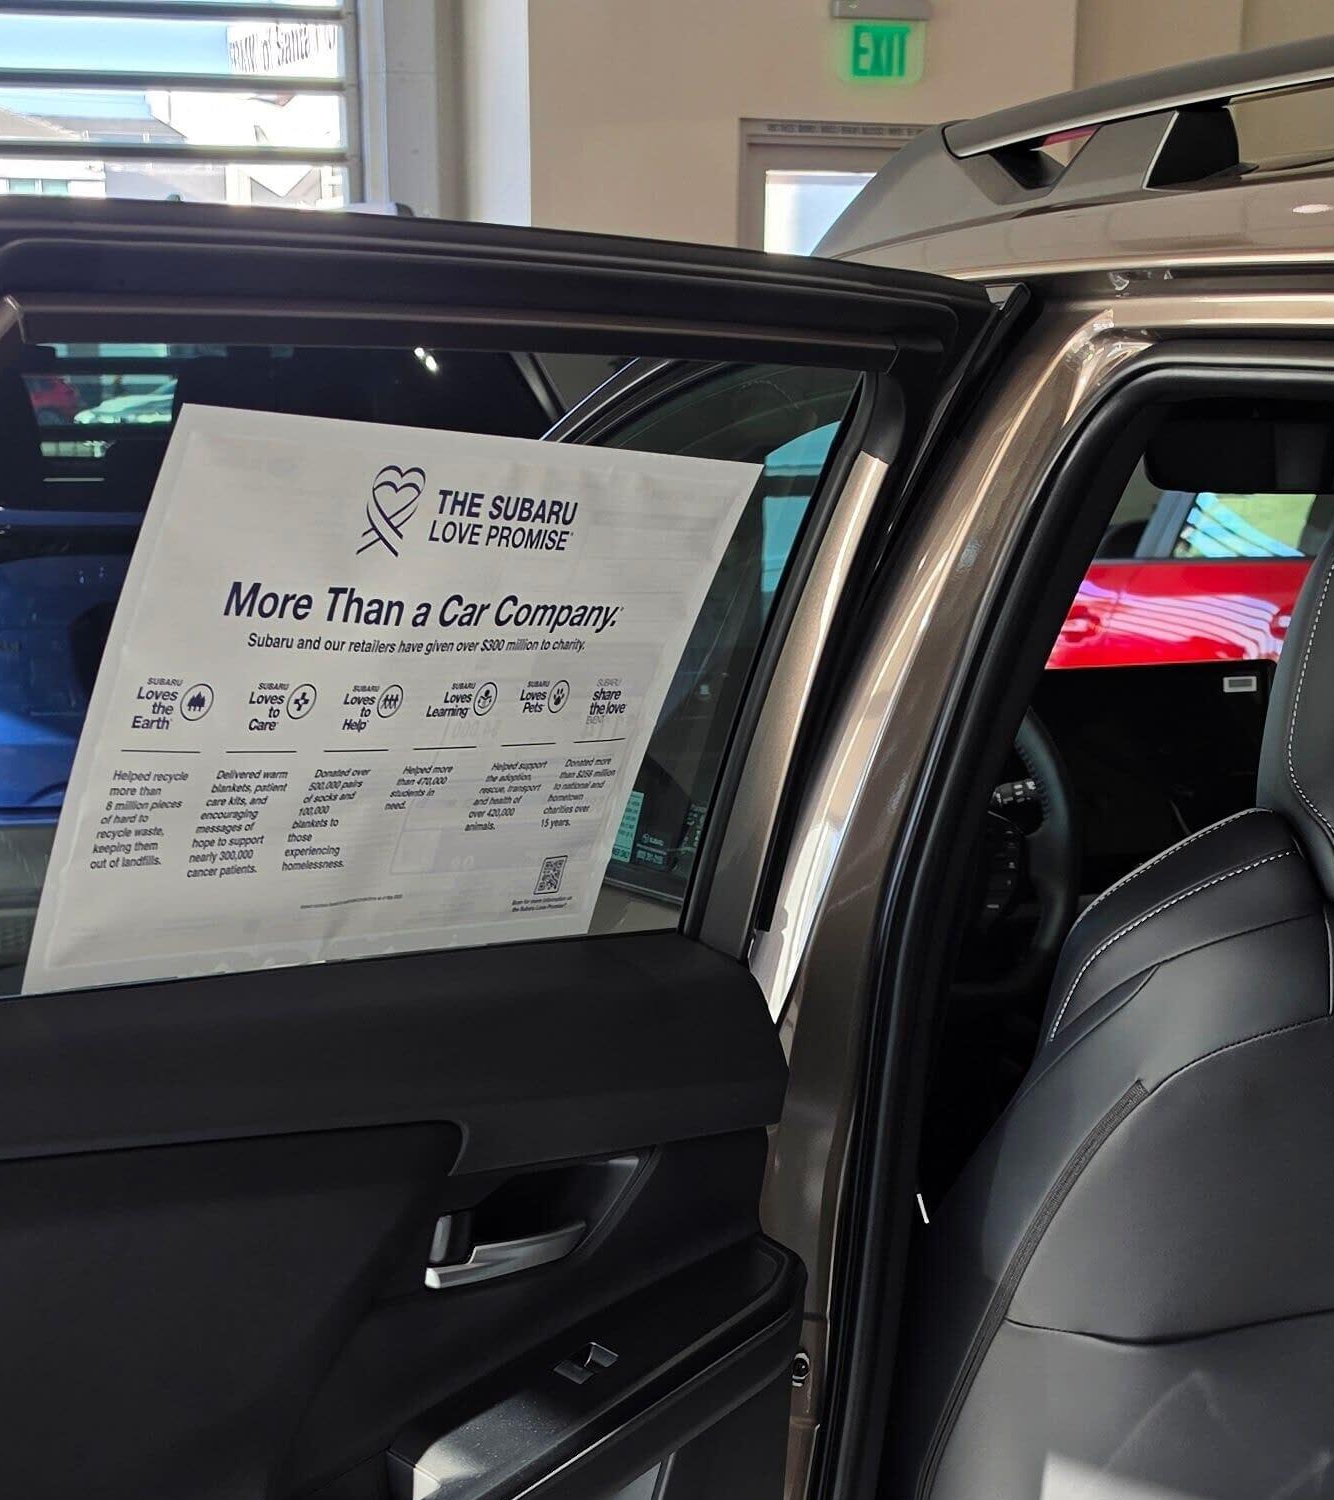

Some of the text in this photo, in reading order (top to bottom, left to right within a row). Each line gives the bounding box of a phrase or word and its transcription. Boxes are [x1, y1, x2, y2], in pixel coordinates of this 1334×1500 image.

[854, 25, 911, 76] EXIT
[436, 489, 579, 527] THE SUBARU
[428, 520, 573, 552] LOVE PROMISE
[223, 581, 620, 634] More Than a Car Company.
[247, 632, 586, 656] Subaru and our retailers have given over $300 million to charity.
[147, 677, 183, 687] SUBARU
[258, 682, 290, 691] SUBARU
[452, 682, 476, 690] SUBARU
[527, 680, 550, 688] SUBARU
[136, 686, 179, 701] Loves
[352, 684, 380, 693] SUBARU
[519, 688, 547, 701] Loves
[592, 688, 622, 701] share
[248, 692, 285, 705] Loves
[342, 693, 376, 706] Loves
[443, 691, 472, 704] Loves
[151, 701, 174, 716] the
[267, 706, 280, 718] to
[360, 706, 371, 718] to
[425, 705, 470, 719] Learning
[522, 702, 544, 714] Pets
[589, 701, 626, 715] the love
[131, 716, 170, 730] Earth
[248, 718, 277, 731] Care
[342, 718, 367, 732] Help
[491, 761, 548, 772] Helped support
[565, 757, 612, 768] Donated more
[113, 770, 189, 783] Helped recycle
[216, 769, 288, 780] Delivered warm
[314, 767, 371, 778] Donated over
[403, 765, 453, 776] Helped more
[396, 778, 416, 786] than
[485, 774, 498, 782] the
[109, 784, 162, 796] more than
[211, 782, 287, 795] blankets, patient
[340, 780, 364, 791] pairs
[507, 784, 542, 794] transport
[590, 780, 606, 789] and
[303, 791, 357, 803] of socks and
[389, 788, 436, 798] students in
[547, 792, 584, 803] hometown
[114, 800, 149, 811] million
[149, 799, 183, 812] pieces
[205, 796, 269, 807] care kits, and
[473, 795, 523, 806] and health of
[200, 809, 259, 822] encouraging
[468, 810, 486, 819] over
[543, 804, 590, 815] charities over
[100, 814, 149, 825] of hard to
[292, 818, 339, 830] blankets to
[540, 818, 550, 828] 15
[96, 826, 165, 840] recycle waste,
[195, 821, 256, 835] messages of
[191, 835, 265, 850] hope to support
[287, 832, 312, 843] those
[92, 841, 159, 856] keeping them
[284, 845, 340, 858] experiencing
[90, 855, 162, 869] out of landfills.
[189, 849, 254, 865] nearly 300,000
[186, 864, 257, 878] cancer patients.
[282, 859, 345, 871] homelessness.
